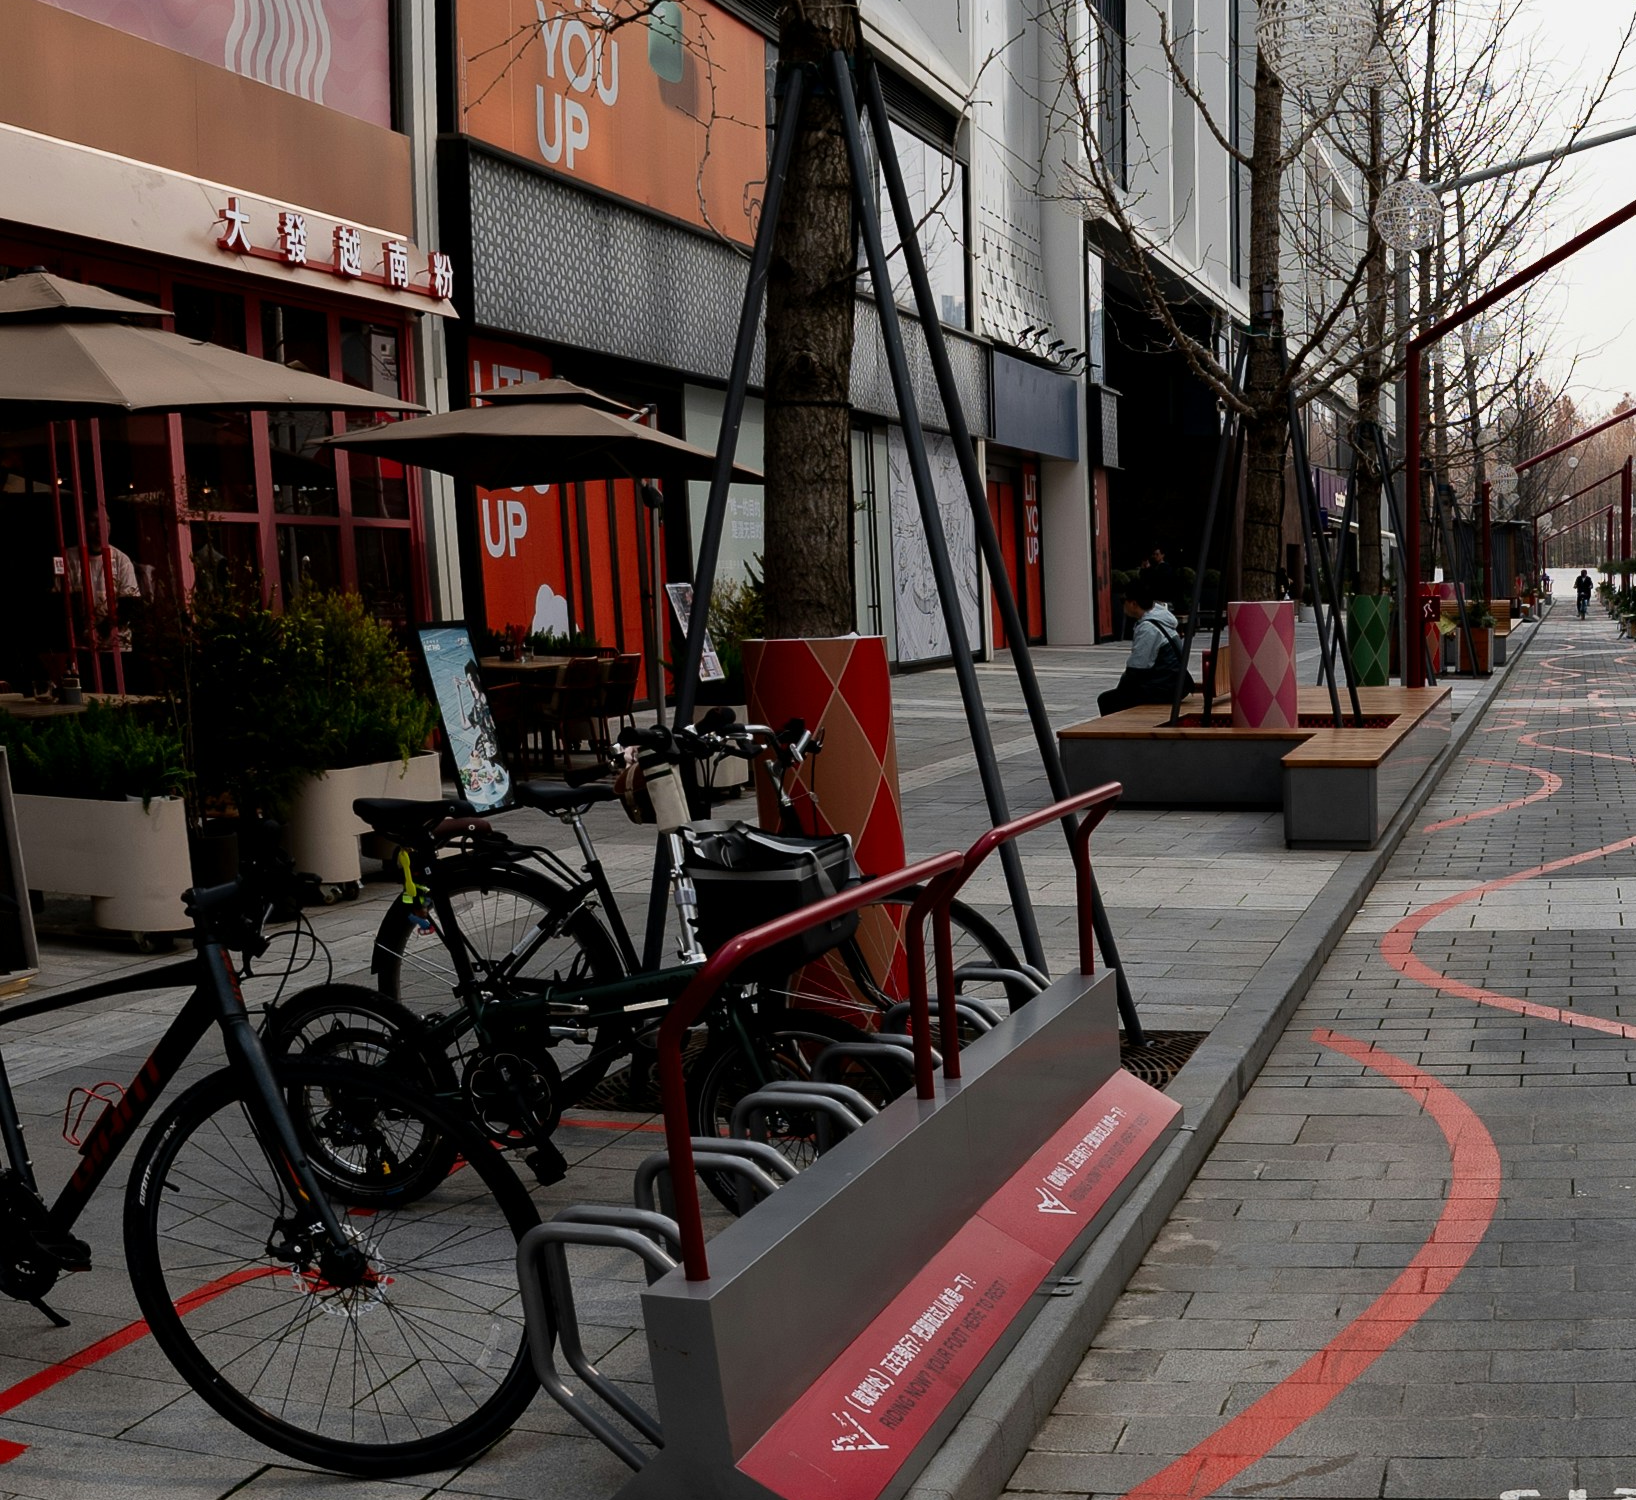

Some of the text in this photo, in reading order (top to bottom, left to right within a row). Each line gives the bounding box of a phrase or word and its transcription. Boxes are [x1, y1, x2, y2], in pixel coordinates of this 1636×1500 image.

[536, 85, 590, 171] UP
[218, 197, 454, 299] 大發越南粉
[482, 499, 528, 558] UP
[1027, 537, 1040, 565] UP
[139, 1164, 152, 1206] GIANT
[879, 1393, 915, 1431] RIDING
[903, 1369, 937, 1401] NOW?
[924, 1347, 955, 1375] YOUR
[942, 1326, 970, 1352] FOOT
[960, 1307, 988, 1333] HERE
[975, 1295, 995, 1312] TO
